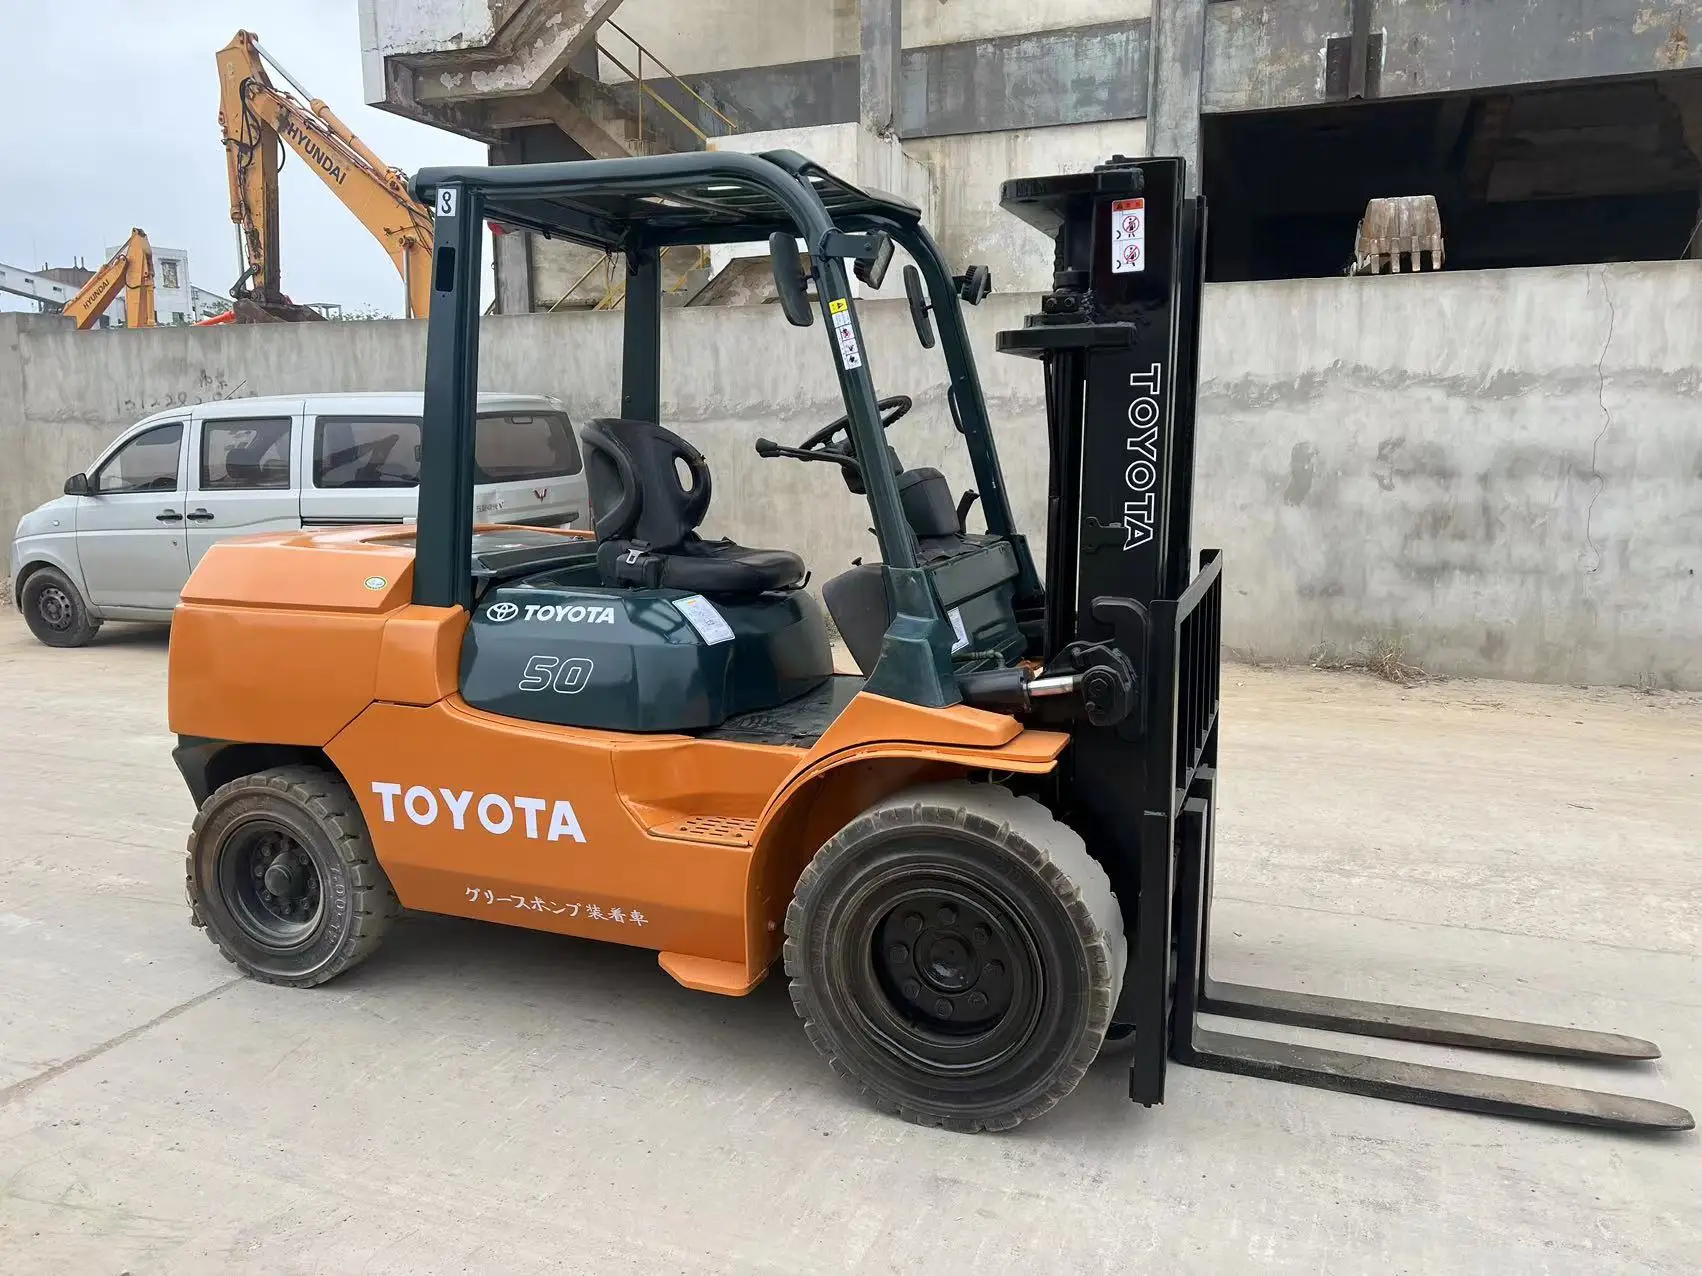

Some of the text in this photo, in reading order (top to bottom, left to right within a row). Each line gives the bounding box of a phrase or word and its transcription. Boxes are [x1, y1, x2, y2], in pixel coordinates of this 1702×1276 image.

[287, 122, 347, 185] HYUNDAI
[82, 279, 110, 310] HYUNDAI
[1123, 362, 1162, 551] TOYOTA
[523, 604, 615, 625] TOYOTA
[518, 655, 594, 694] 50
[371, 781, 587, 843] TOYOTA
